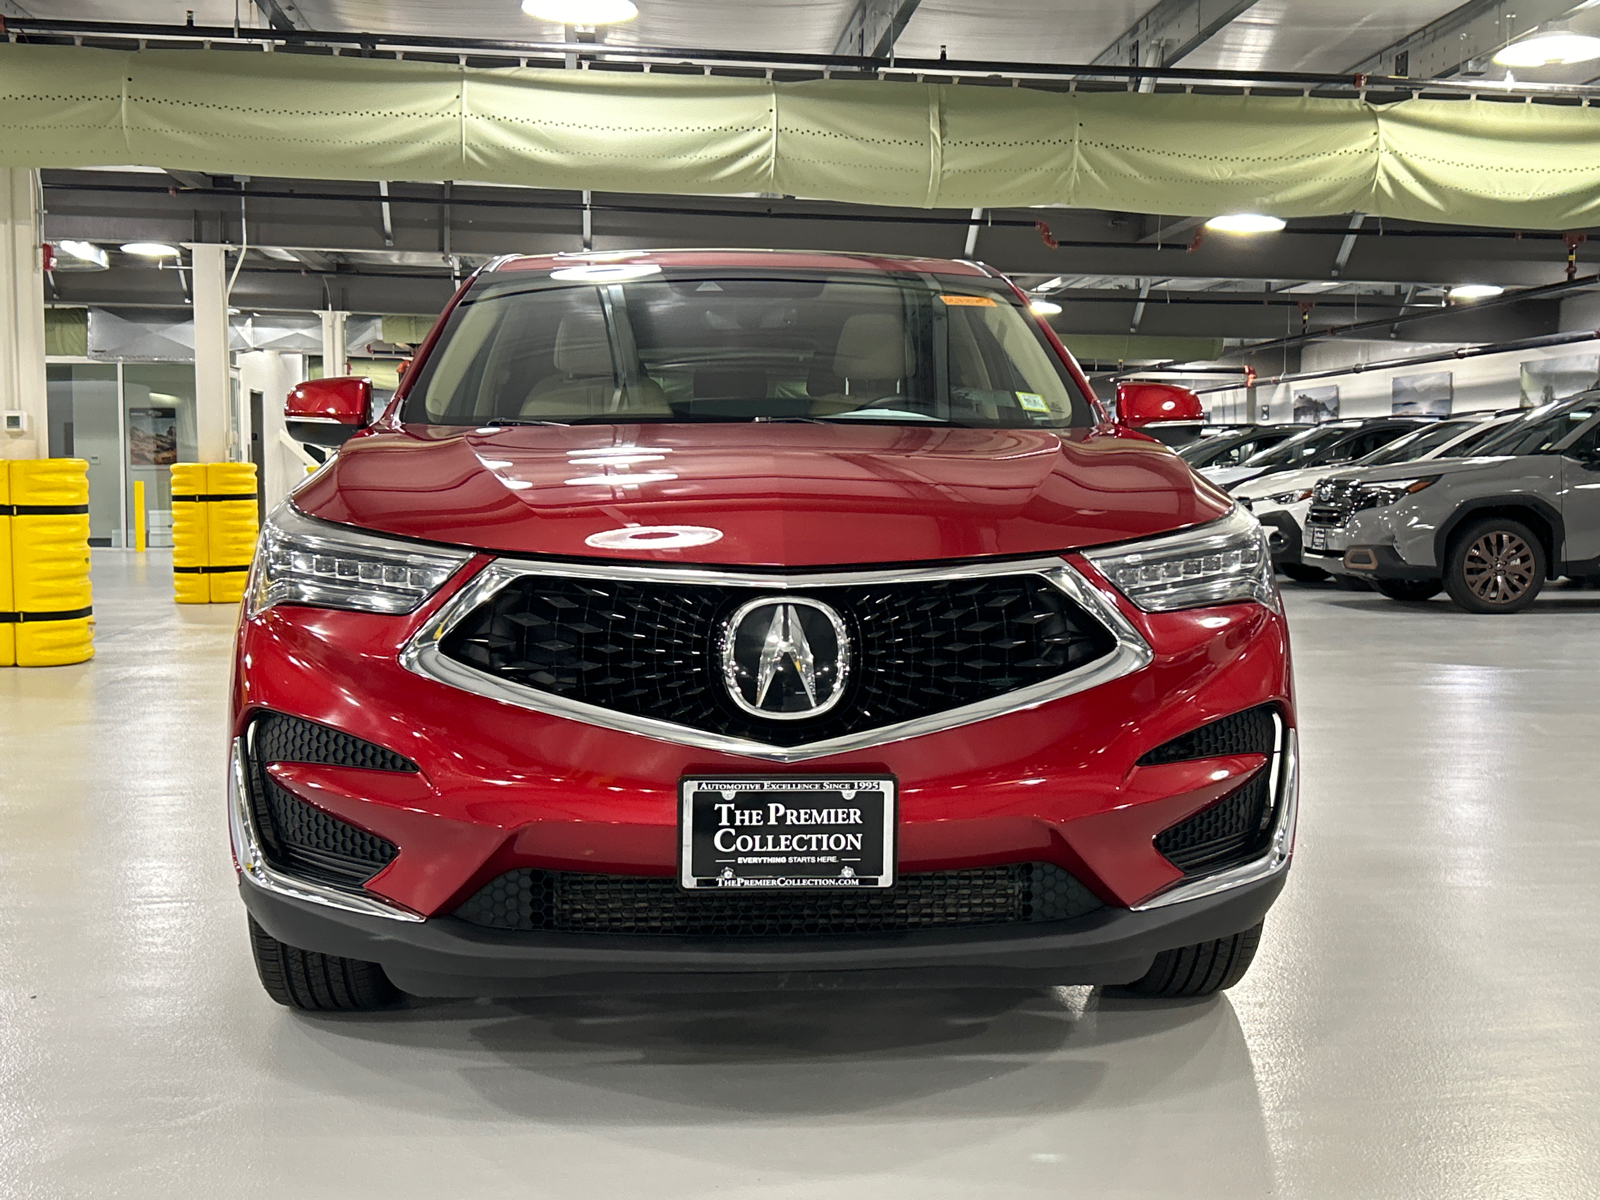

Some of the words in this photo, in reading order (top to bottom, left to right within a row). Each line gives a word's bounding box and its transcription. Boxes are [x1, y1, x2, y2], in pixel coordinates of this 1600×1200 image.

[700, 782, 761, 790] AUTOMOTIVE
[763, 782, 820, 790] EXCELLENCE
[823, 781, 850, 790] SINCE
[853, 781, 878, 790] 1995
[714, 803, 763, 826] THE
[767, 803, 863, 825] PREMIER
[714, 828, 863, 852] COLLECTION
[737, 856, 787, 864] EVERYTHING
[788, 856, 816, 864] STARTS
[816, 855, 839, 863] HERE.
